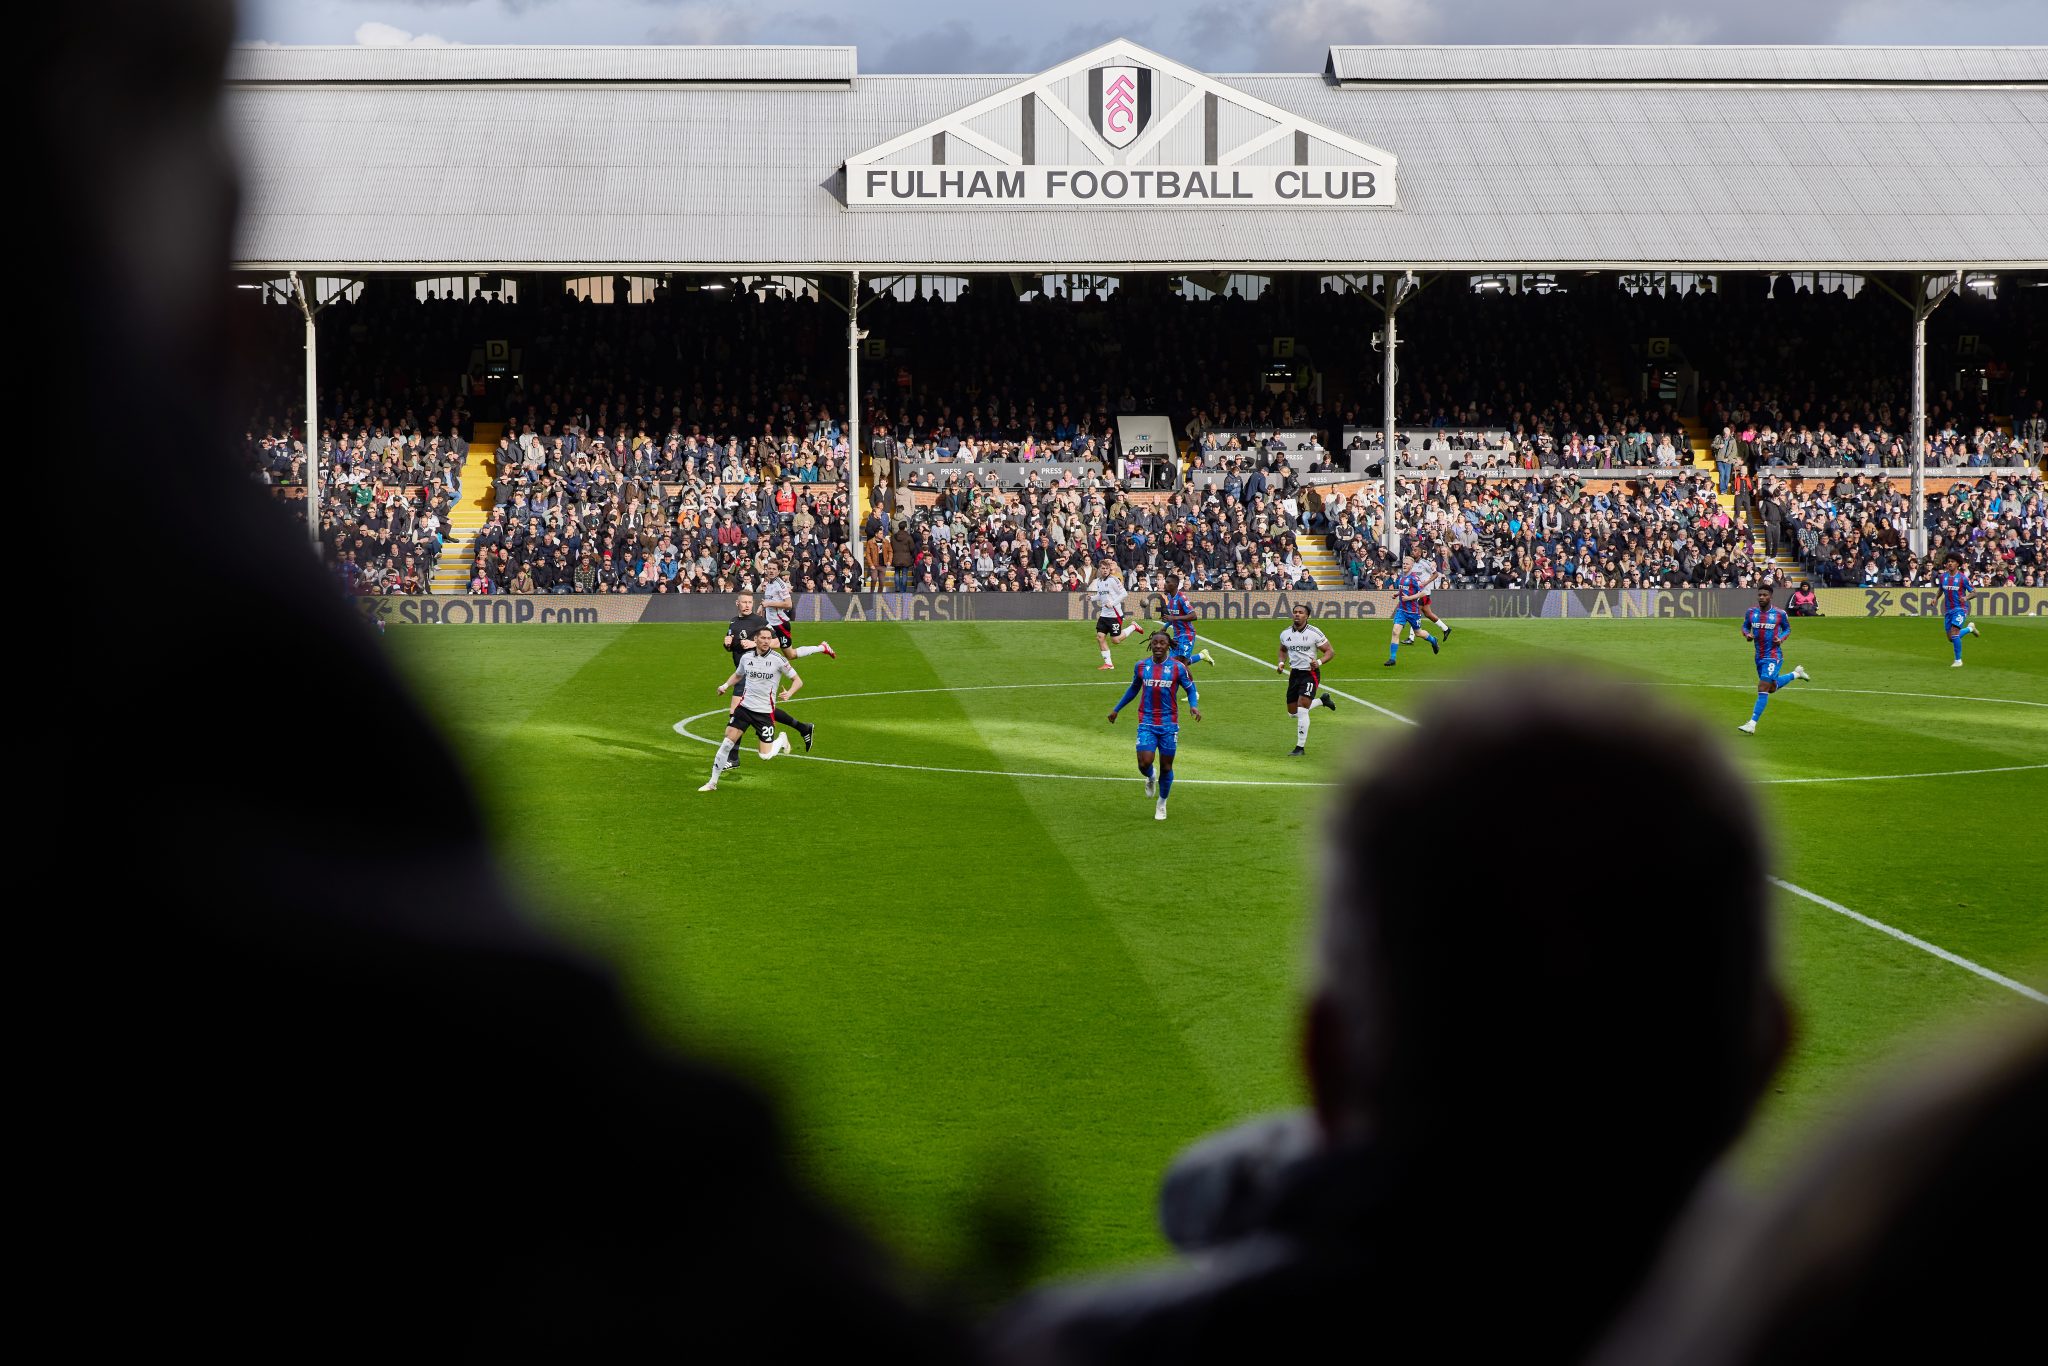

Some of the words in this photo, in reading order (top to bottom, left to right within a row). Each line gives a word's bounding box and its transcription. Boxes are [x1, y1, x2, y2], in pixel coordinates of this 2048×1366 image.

[1105, 74, 1135, 133] FFC
[867, 171, 1026, 199] FULHAM
[1046, 170, 1253, 199] FOOTBALL
[1275, 170, 1377, 199] CLUB
[492, 343, 504, 357] D
[869, 343, 881, 356] E
[1279, 340, 1288, 354] F
[1653, 341, 1666, 354] G
[1133, 444, 1153, 452] exit
[1041, 467, 1063, 475] PRESS
[1112, 623, 1120, 631] 32
[1767, 662, 1775, 672] 8
[749, 671, 774, 680] SBOTOP
[1306, 682, 1314, 692] 11
[762, 725, 774, 737] 20
